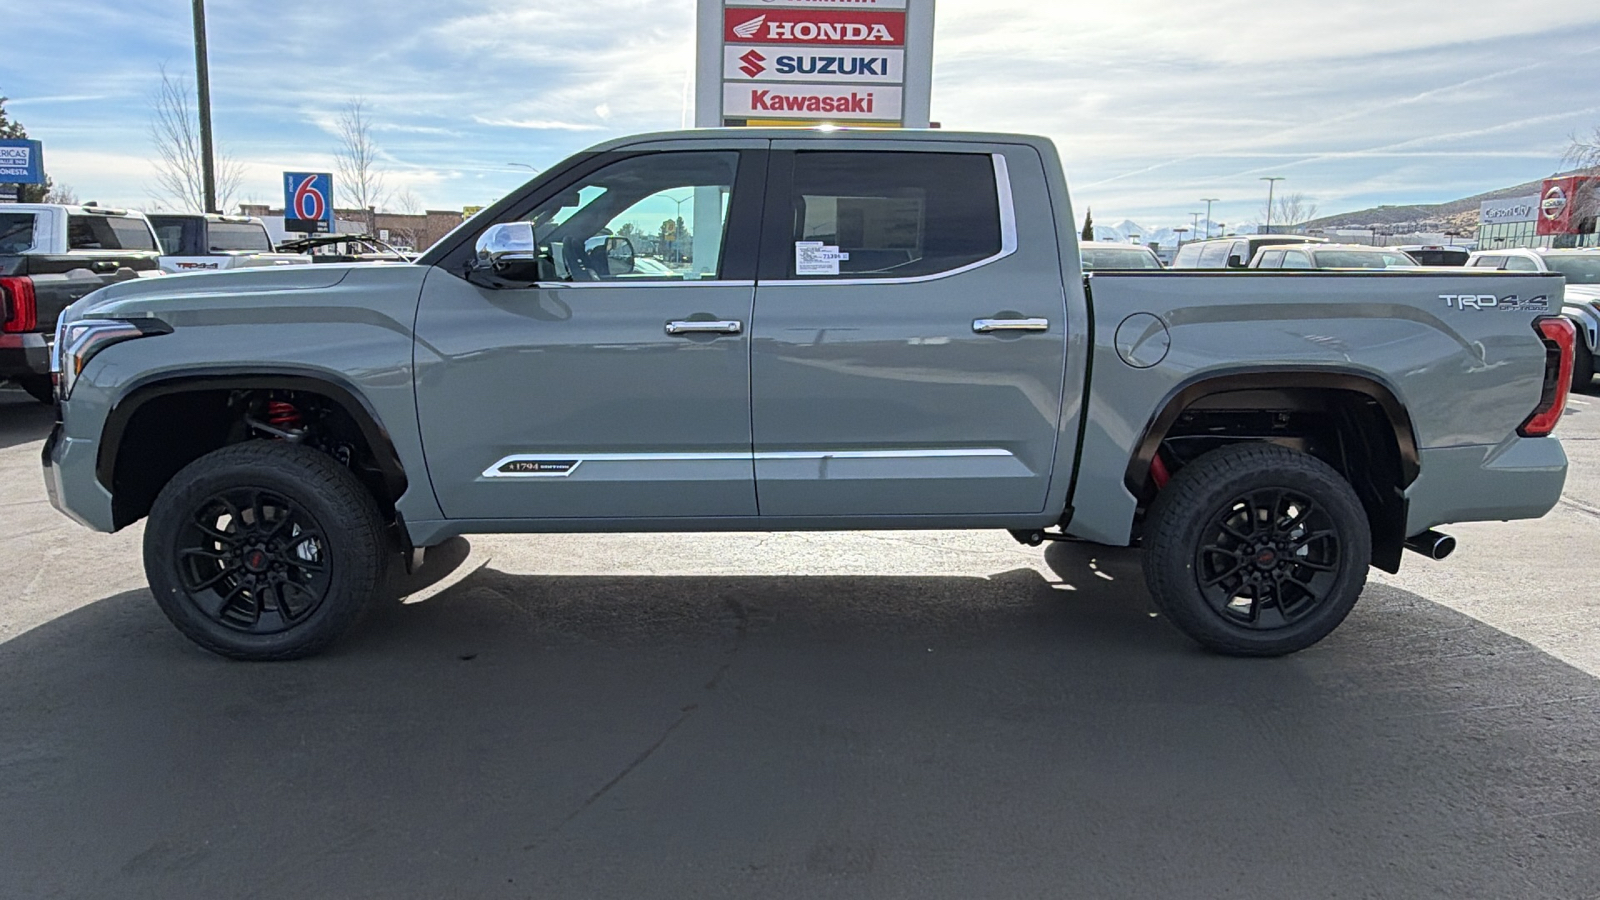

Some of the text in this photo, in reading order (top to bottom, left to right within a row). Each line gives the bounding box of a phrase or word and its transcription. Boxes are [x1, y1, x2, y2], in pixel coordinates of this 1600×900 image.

[766, 21, 894, 42] HONDA
[775, 55, 888, 76] SUZUKI
[751, 89, 874, 113] Kawasaki
[293, 174, 325, 220] 6
[1485, 204, 1531, 218] Carson City
[1438, 294, 1498, 311] TRD
